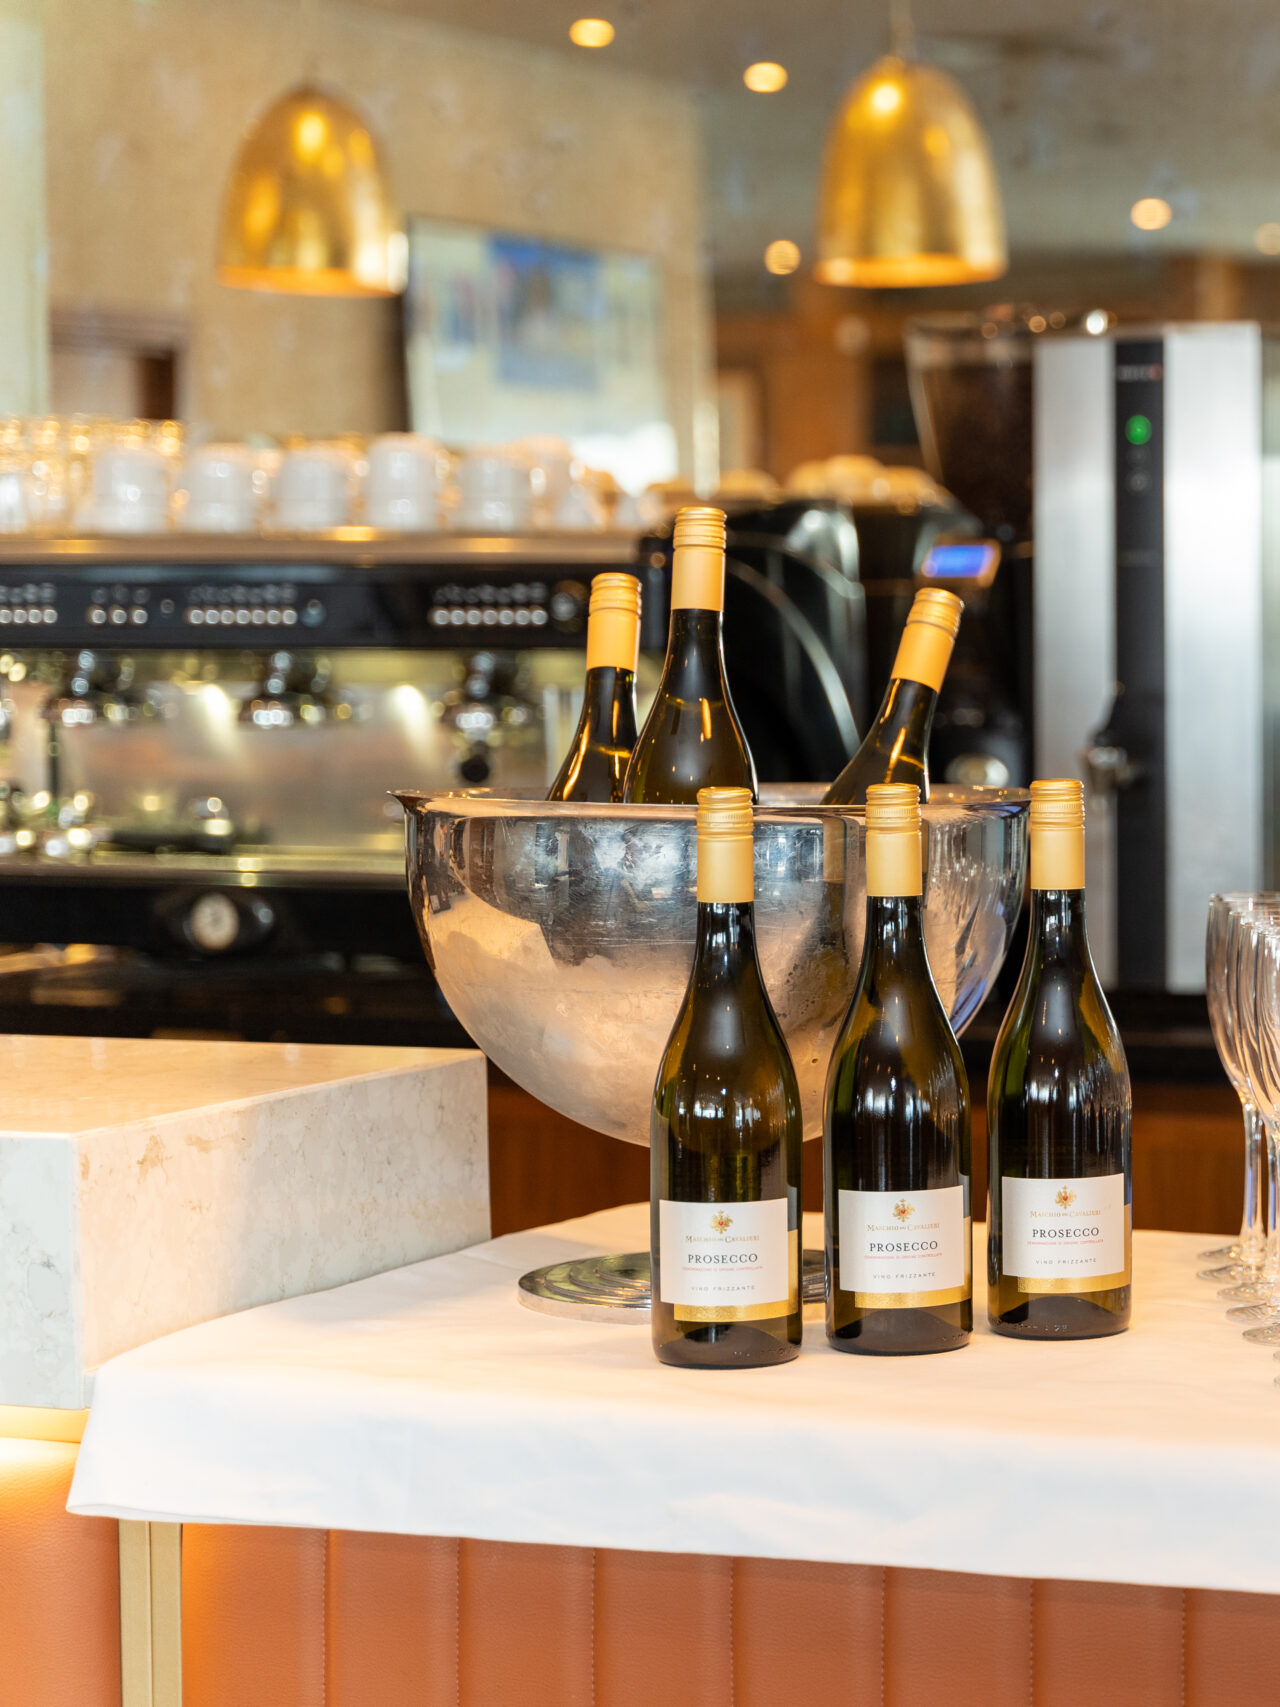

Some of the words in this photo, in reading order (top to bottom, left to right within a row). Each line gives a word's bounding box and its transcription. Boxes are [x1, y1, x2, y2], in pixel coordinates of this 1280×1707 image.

[1032, 1227, 1100, 1239] PROSECCO
[869, 1240, 939, 1252] PROSECCO
[687, 1253, 758, 1264] PROSECCO
[1057, 1257, 1097, 1265] FRIZZANTE
[895, 1271, 936, 1279] FRIZZANTE
[713, 1284, 755, 1292] FRIZZANTE
